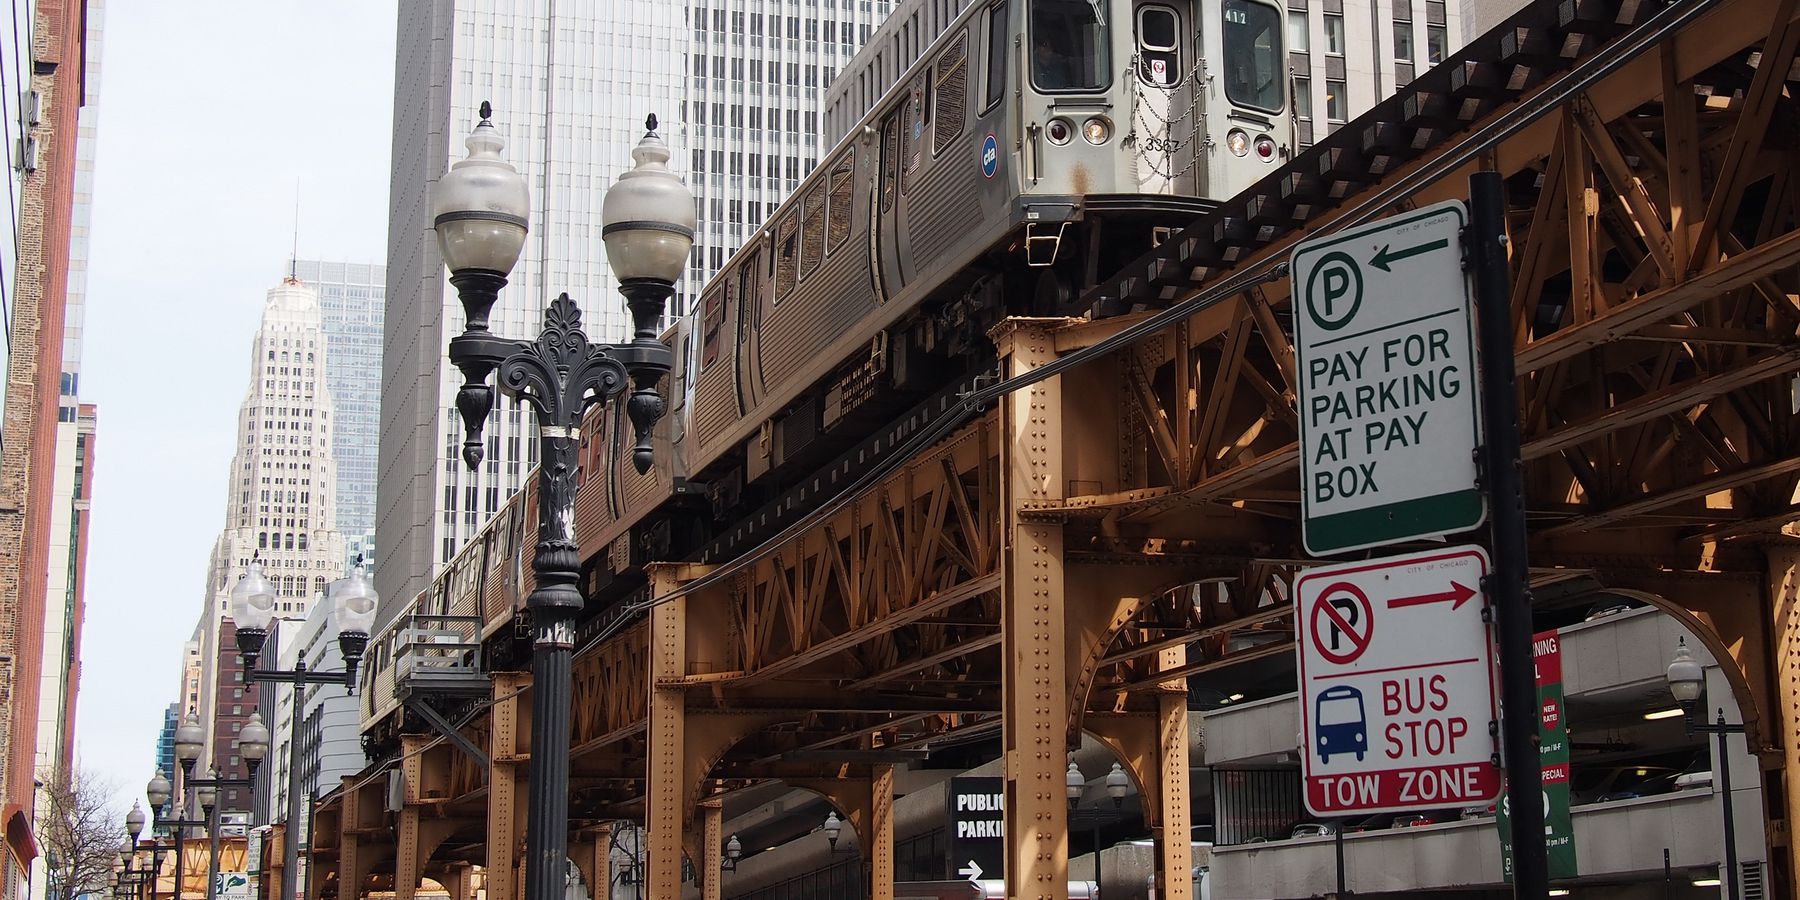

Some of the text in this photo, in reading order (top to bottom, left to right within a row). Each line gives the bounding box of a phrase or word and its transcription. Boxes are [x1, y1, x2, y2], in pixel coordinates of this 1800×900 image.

[983, 147, 996, 166] cta
[1145, 137, 1179, 151] 3367
[1309, 328, 1450, 389] PAY FOR
[1311, 366, 1460, 427] PARKING
[1314, 411, 1428, 464] AT PAY
[1314, 461, 1379, 503] BOX
[1440, 560, 1469, 569] CHICAGO
[1533, 638, 1557, 657] NING
[1382, 674, 1448, 716] BUS
[1544, 704, 1556, 713] NEW
[1385, 717, 1468, 759] STOP
[1318, 766, 1483, 807] TOW ZONE
[1542, 768, 1565, 780] PECIAL
[957, 820, 1004, 838] PARKI
